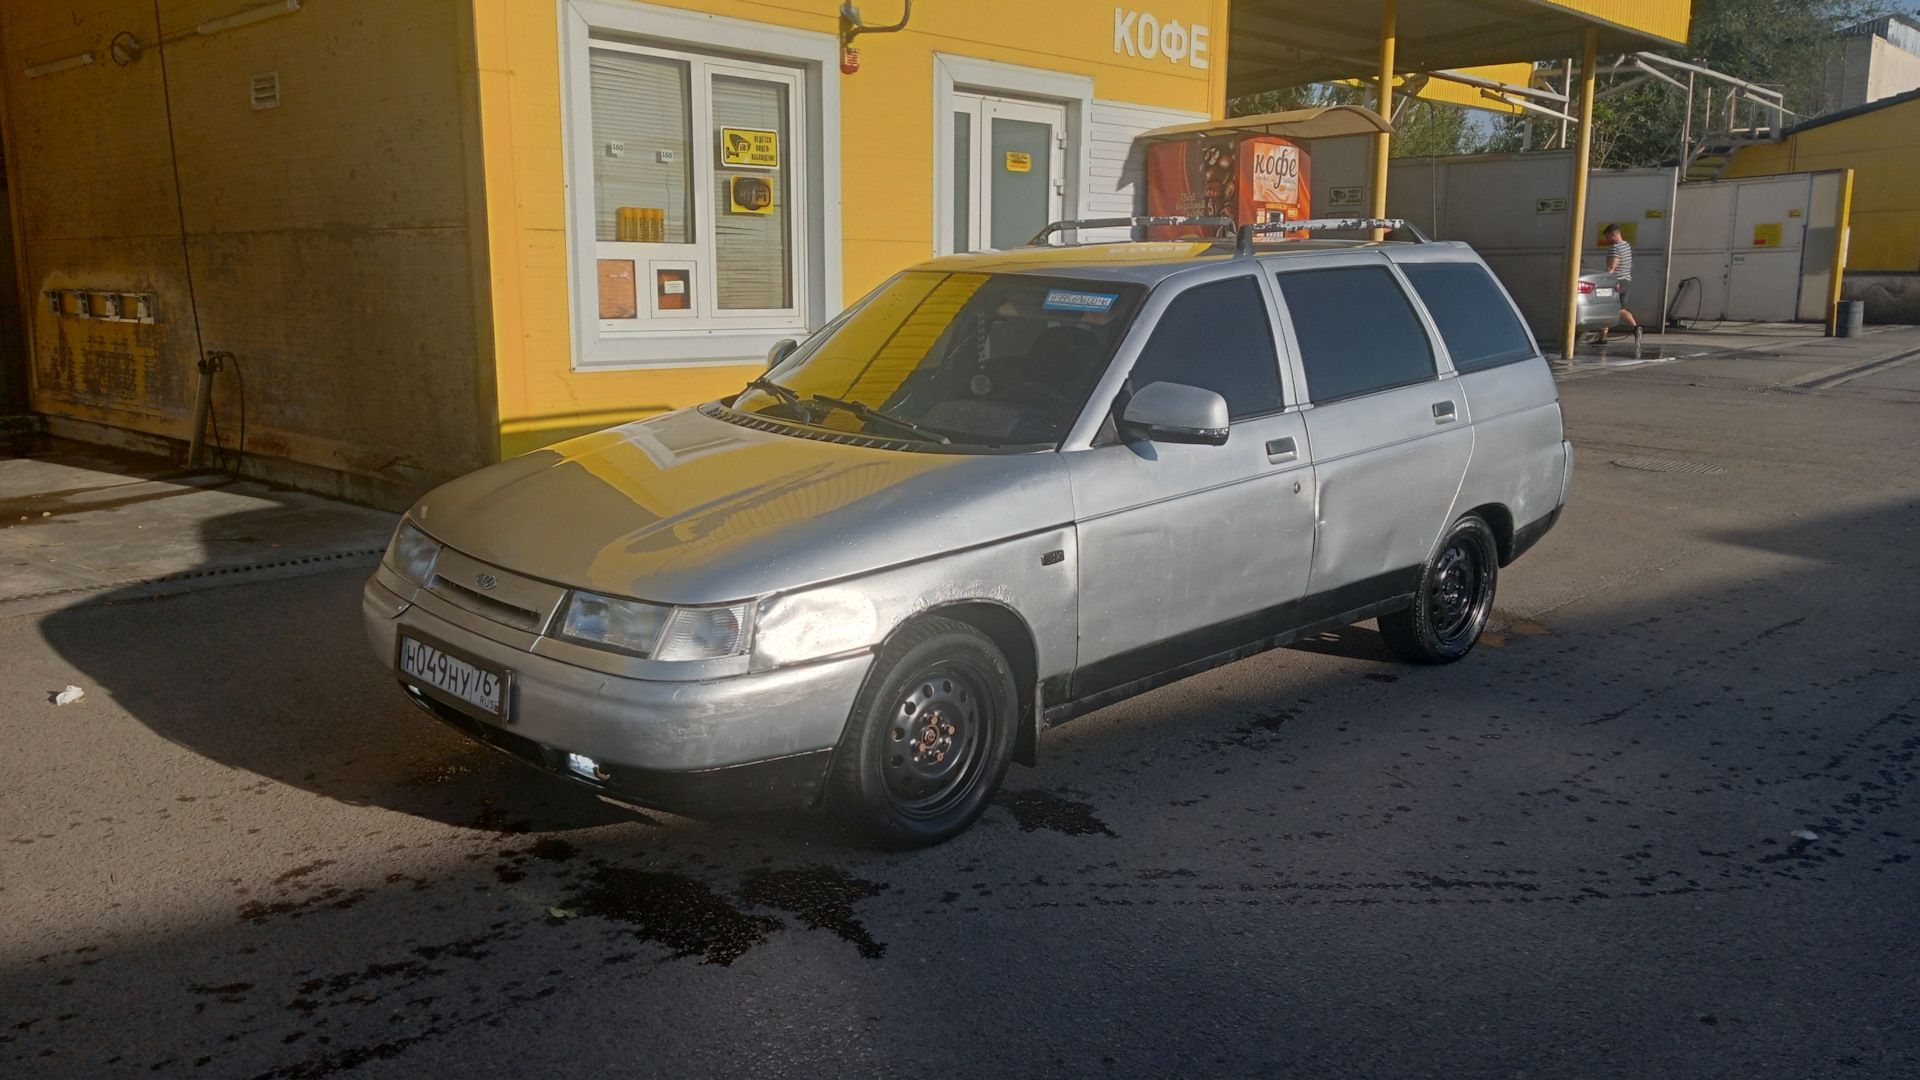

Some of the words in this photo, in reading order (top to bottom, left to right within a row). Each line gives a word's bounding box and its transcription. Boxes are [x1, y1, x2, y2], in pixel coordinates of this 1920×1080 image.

[1113, 7, 1209, 70] КОФЕ
[612, 143, 624, 151] 160
[662, 151, 673, 159] 160
[1255, 148, 1298, 190] кофе
[479, 695, 494, 710] RUS
